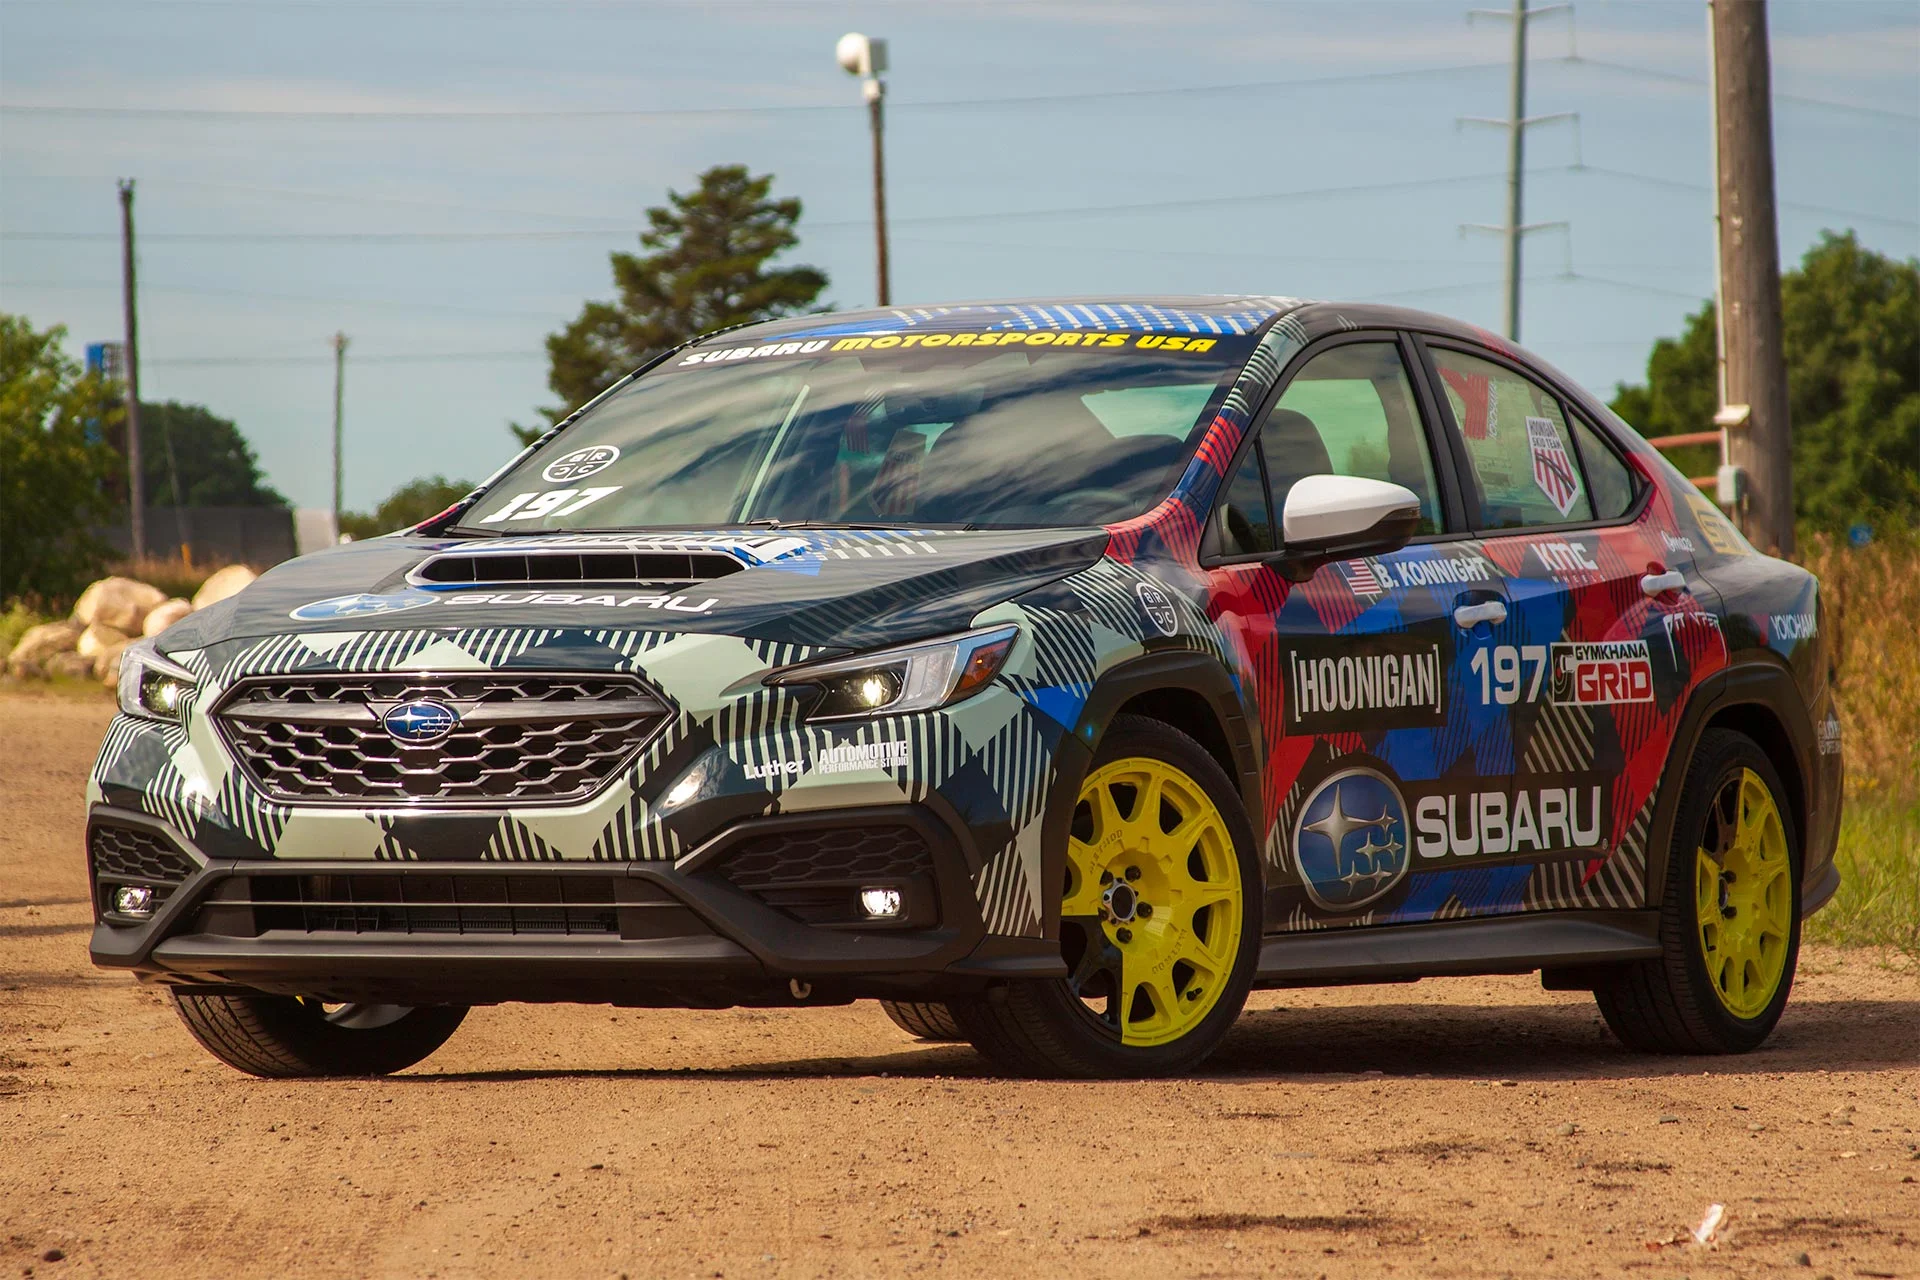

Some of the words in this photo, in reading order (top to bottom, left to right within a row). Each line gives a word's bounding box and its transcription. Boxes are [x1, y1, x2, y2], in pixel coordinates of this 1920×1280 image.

[678, 339, 830, 366] SUBARU
[830, 332, 1130, 351] MOTORSPORTS
[1135, 335, 1218, 352] USA
[479, 486, 623, 524] 197
[1374, 563, 1399, 588] B.
[1400, 557, 1490, 587] KONNIGHT
[444, 591, 719, 613] SUBARU
[1770, 613, 1819, 640] YOKOHAMA
[1575, 643, 1648, 661] GYMKHANA
[1470, 645, 1547, 705] 197
[743, 758, 805, 780] Luther
[818, 741, 909, 765] AUTOMOTIVE
[819, 759, 879, 775] PERFORMANCE
[880, 756, 909, 768] STUDIO
[1416, 786, 1601, 858] SUBARU
